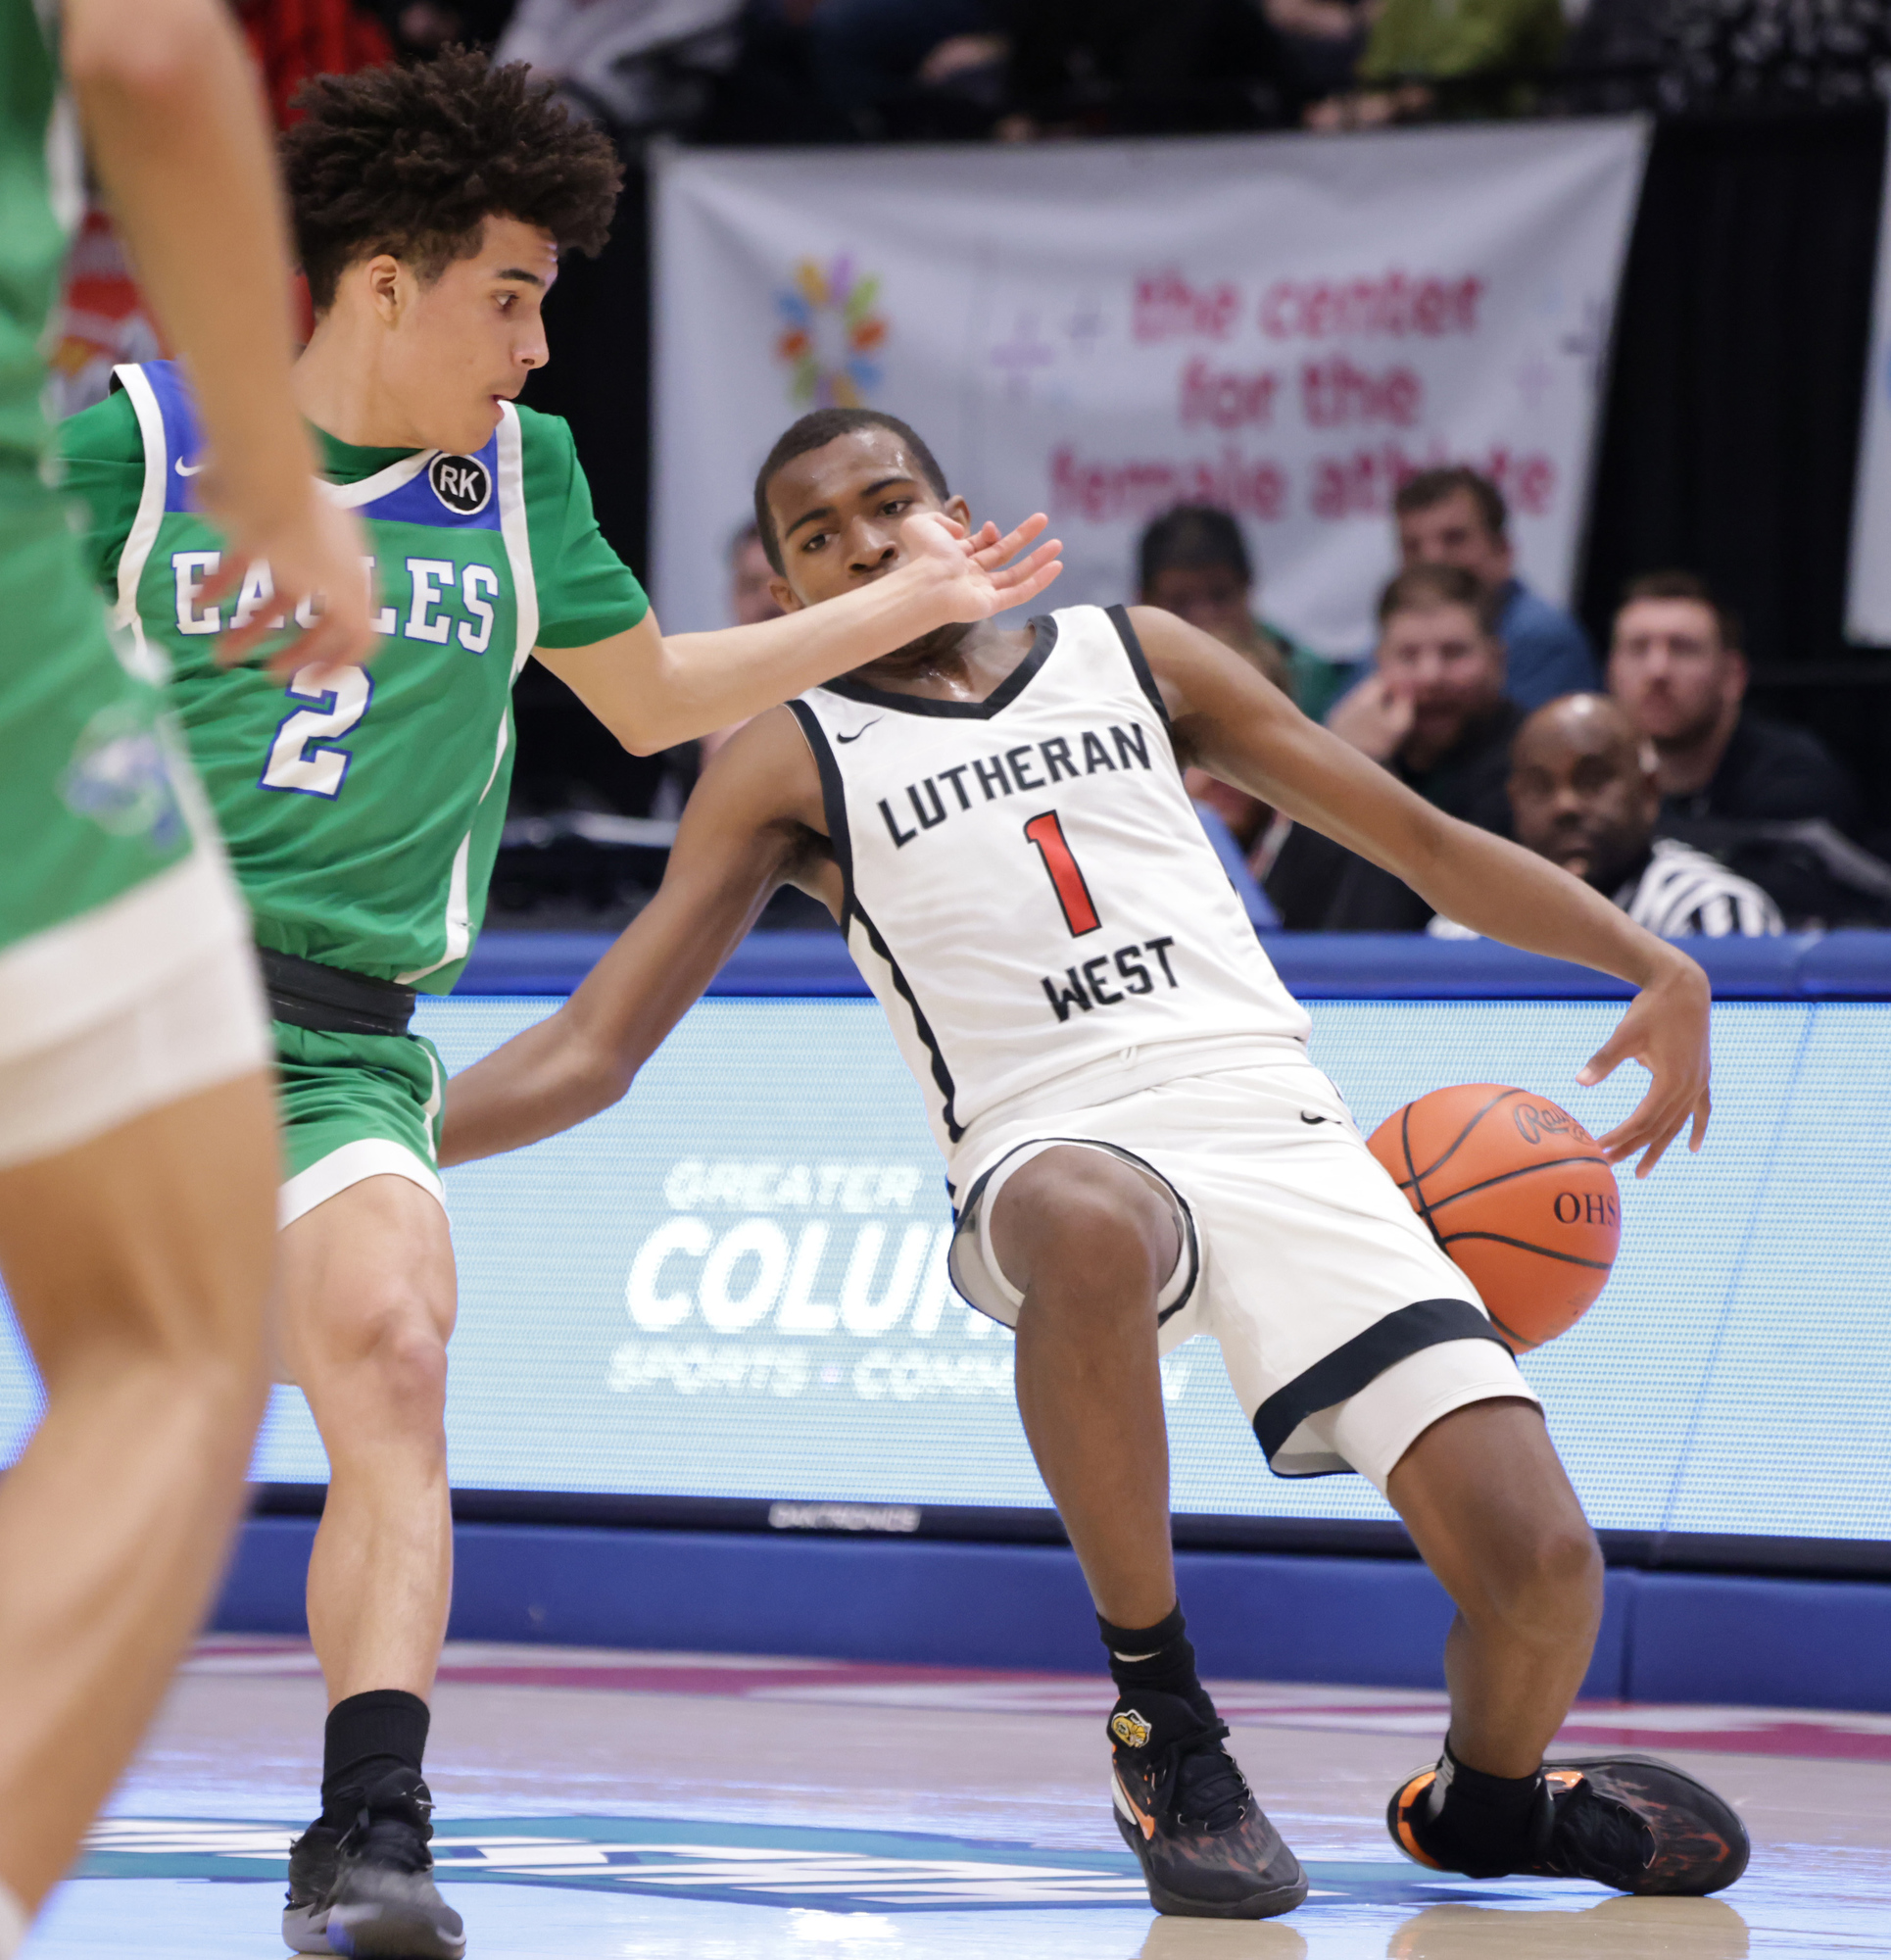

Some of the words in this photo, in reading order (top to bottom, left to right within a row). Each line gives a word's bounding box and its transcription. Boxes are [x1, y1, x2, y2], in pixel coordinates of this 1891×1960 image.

[1133, 266, 1239, 343] the
[1260, 269, 1485, 340] center
[1182, 354, 1277, 432] for
[1299, 355, 1422, 431] the
[440, 464, 480, 502] RK
[257, 662, 375, 802] 2
[878, 722, 1152, 849] LUTHERAN
[1022, 809, 1102, 939] 1
[1040, 936, 1179, 1023] WEST
[663, 1160, 922, 1212] GREATER
